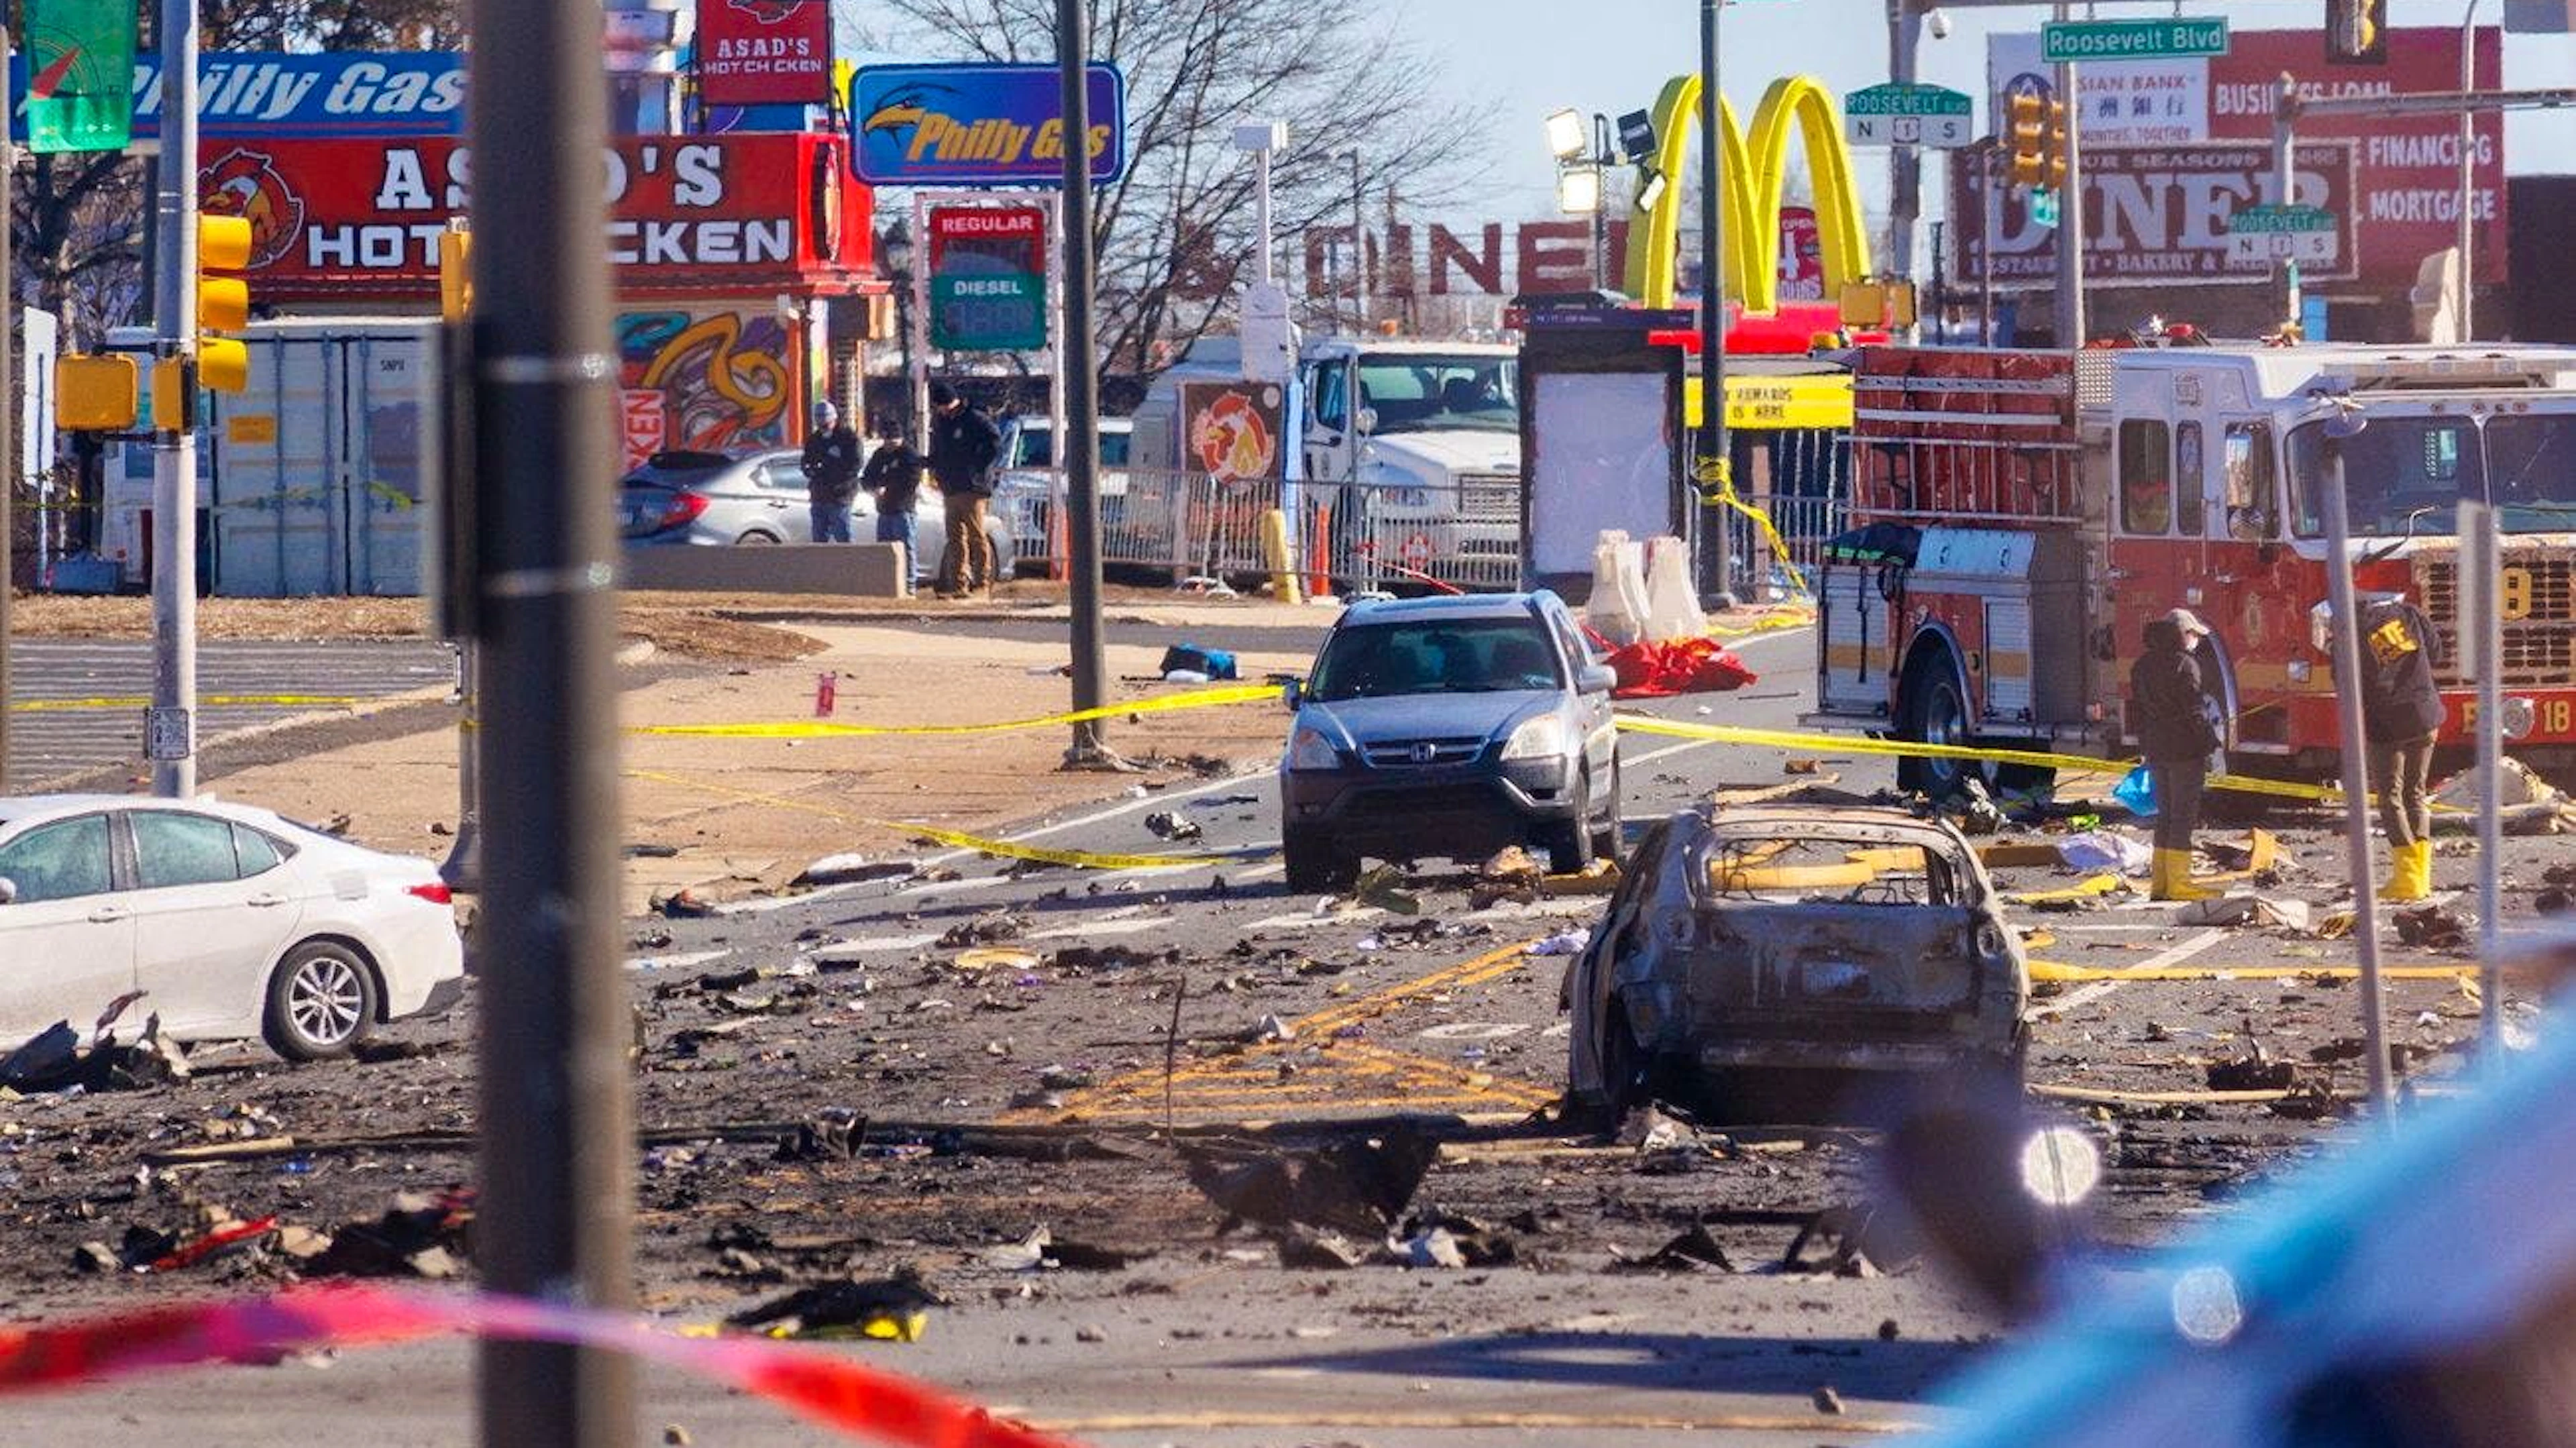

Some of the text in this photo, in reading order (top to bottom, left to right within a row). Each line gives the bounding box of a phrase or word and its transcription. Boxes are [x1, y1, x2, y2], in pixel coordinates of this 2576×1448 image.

[716, 38, 810, 58] ASAD'S
[2049, 23, 2220, 53] Roosevelt Blvd
[705, 59, 822, 74] HOT CHCKEN
[324, 62, 470, 114] Gas
[2078, 74, 2186, 91] SIAN BANK
[1847, 95, 1939, 114] ROOSEVELT
[2216, 81, 2326, 114] BUSISS
[906, 113, 1111, 164] Philly Gs
[1858, 120, 1872, 137] N
[1944, 121, 1957, 139] S
[1969, 172, 2330, 252] DNE
[942, 215, 1034, 233] REGULAR
[308, 225, 445, 267] HOT
[1303, 220, 1680, 298] DINE
[953, 280, 1024, 296] DIESEL
